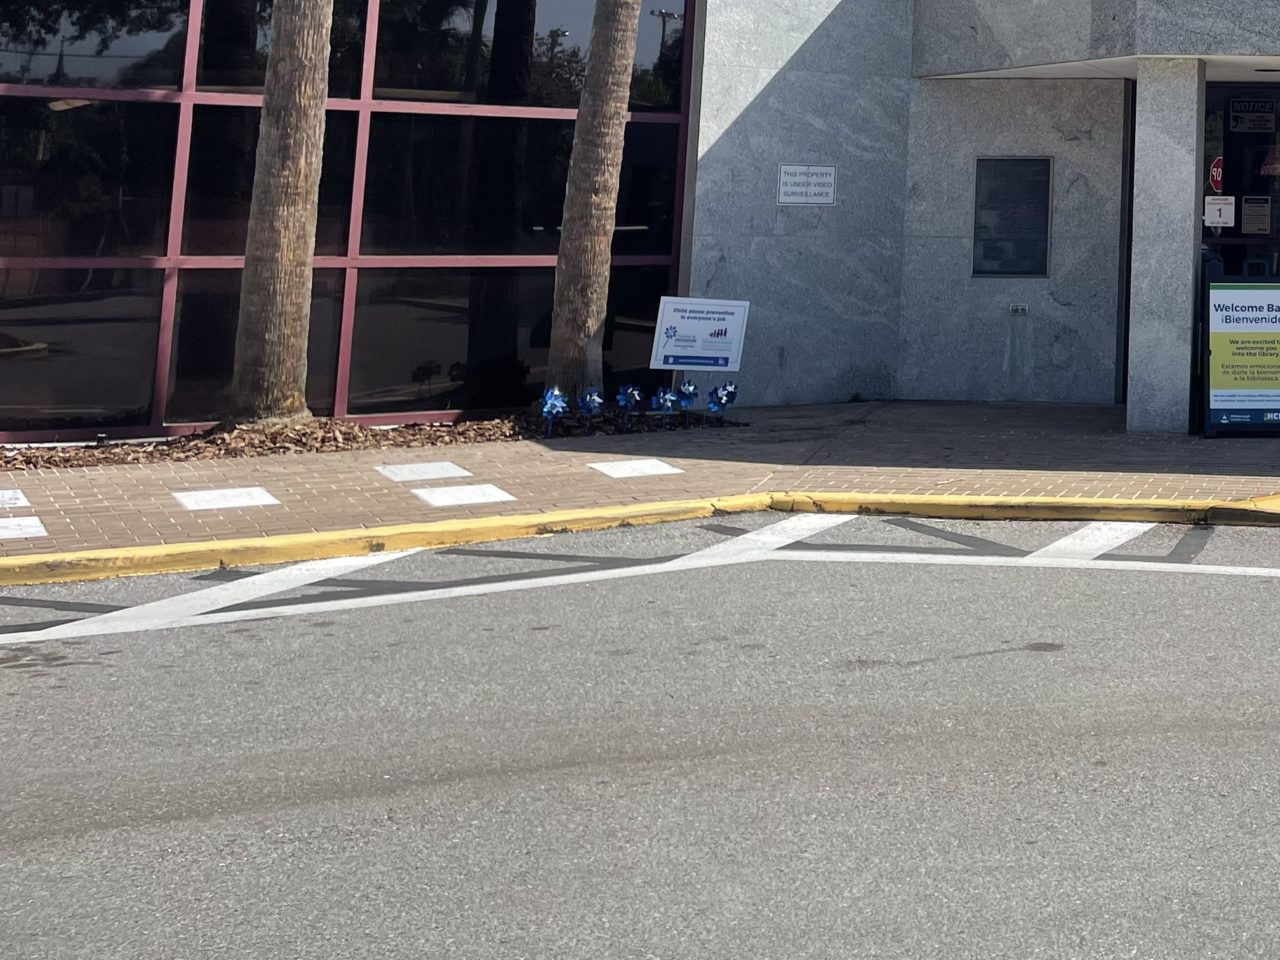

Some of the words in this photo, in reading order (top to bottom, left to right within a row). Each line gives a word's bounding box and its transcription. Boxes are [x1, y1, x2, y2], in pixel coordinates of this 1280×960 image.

[1233, 101, 1273, 112] NOTICE
[1217, 208, 1222, 219] 1
[1213, 303, 1264, 312] Welcome
